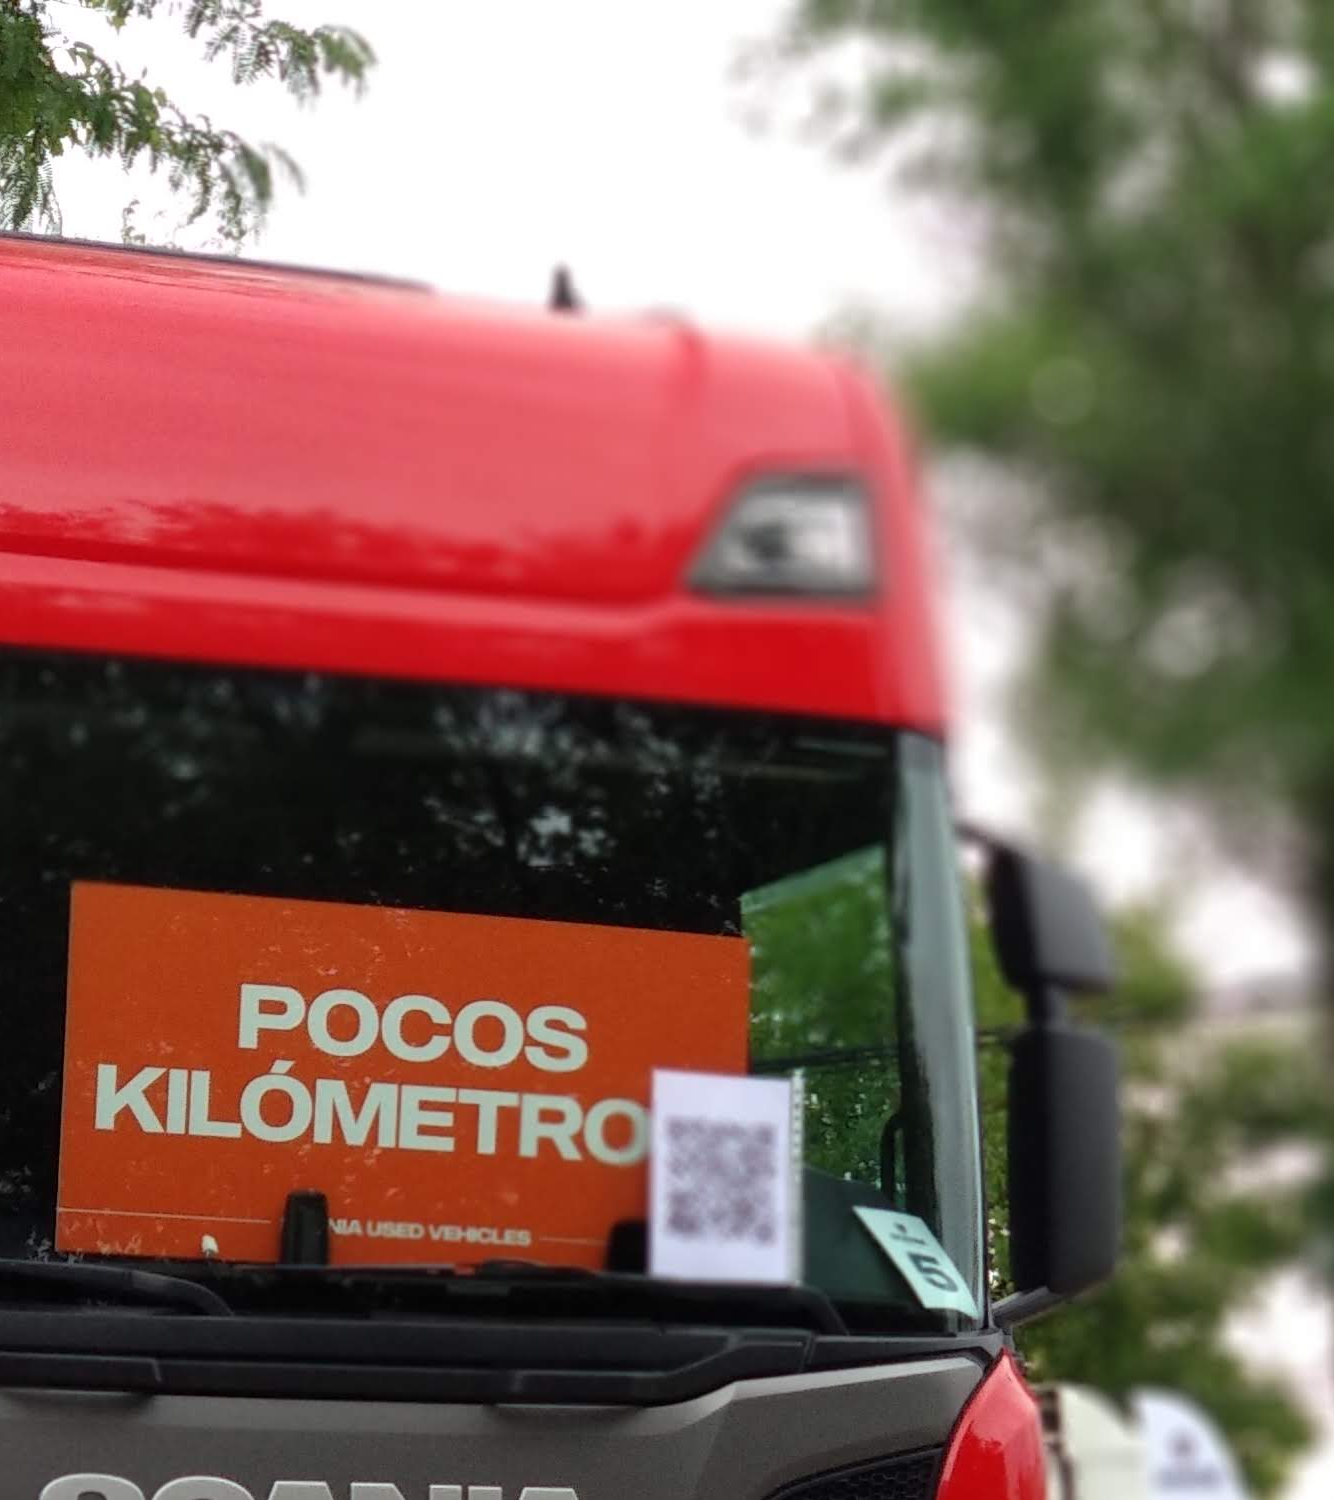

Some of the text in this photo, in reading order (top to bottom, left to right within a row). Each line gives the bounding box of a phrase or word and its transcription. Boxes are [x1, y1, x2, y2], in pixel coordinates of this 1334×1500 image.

[238, 982, 588, 1074] POCOS
[94, 1058, 650, 1166] KILÓMETRO
[368, 1219, 425, 1241] USED
[430, 1224, 532, 1247] VEHICLES
